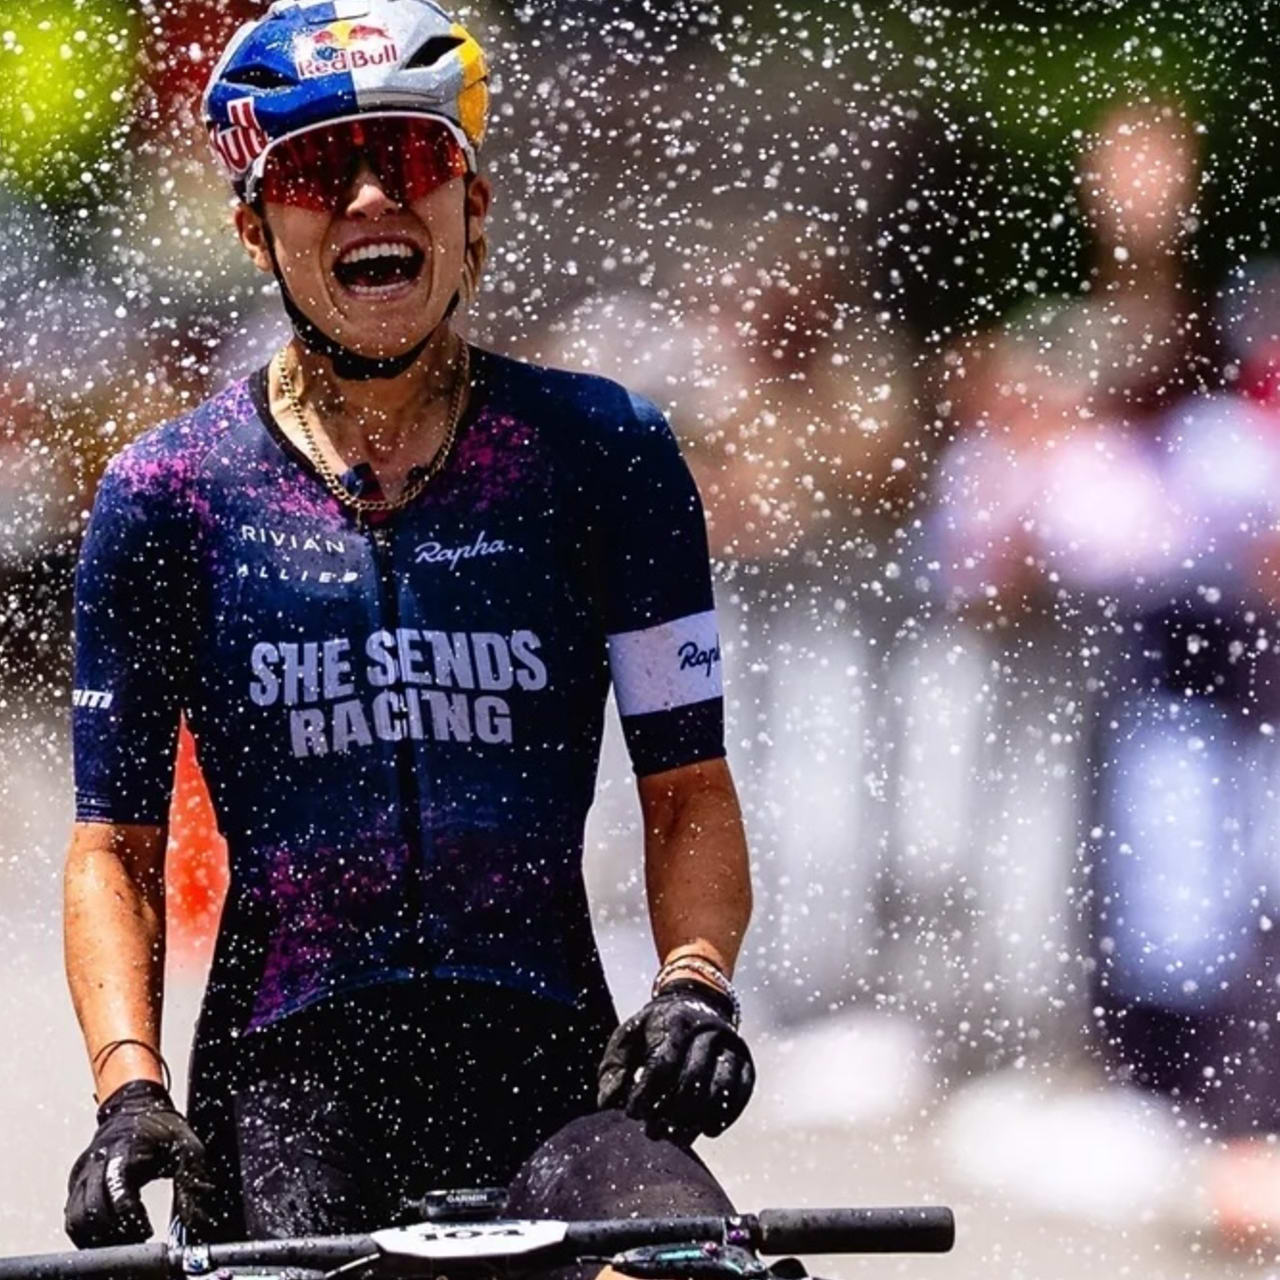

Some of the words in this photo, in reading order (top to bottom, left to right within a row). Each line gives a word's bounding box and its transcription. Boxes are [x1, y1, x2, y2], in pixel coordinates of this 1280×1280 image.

[299, 52, 347, 77] Red
[351, 44, 397, 68] Bull
[241, 524, 345, 553] RIVIAN
[237, 564, 359, 584] ALLIED
[250, 638, 355, 706] SHE
[365, 628, 548, 691] SENDS
[290, 687, 513, 758] RACING
[446, 1193, 488, 1203] GARMIN
